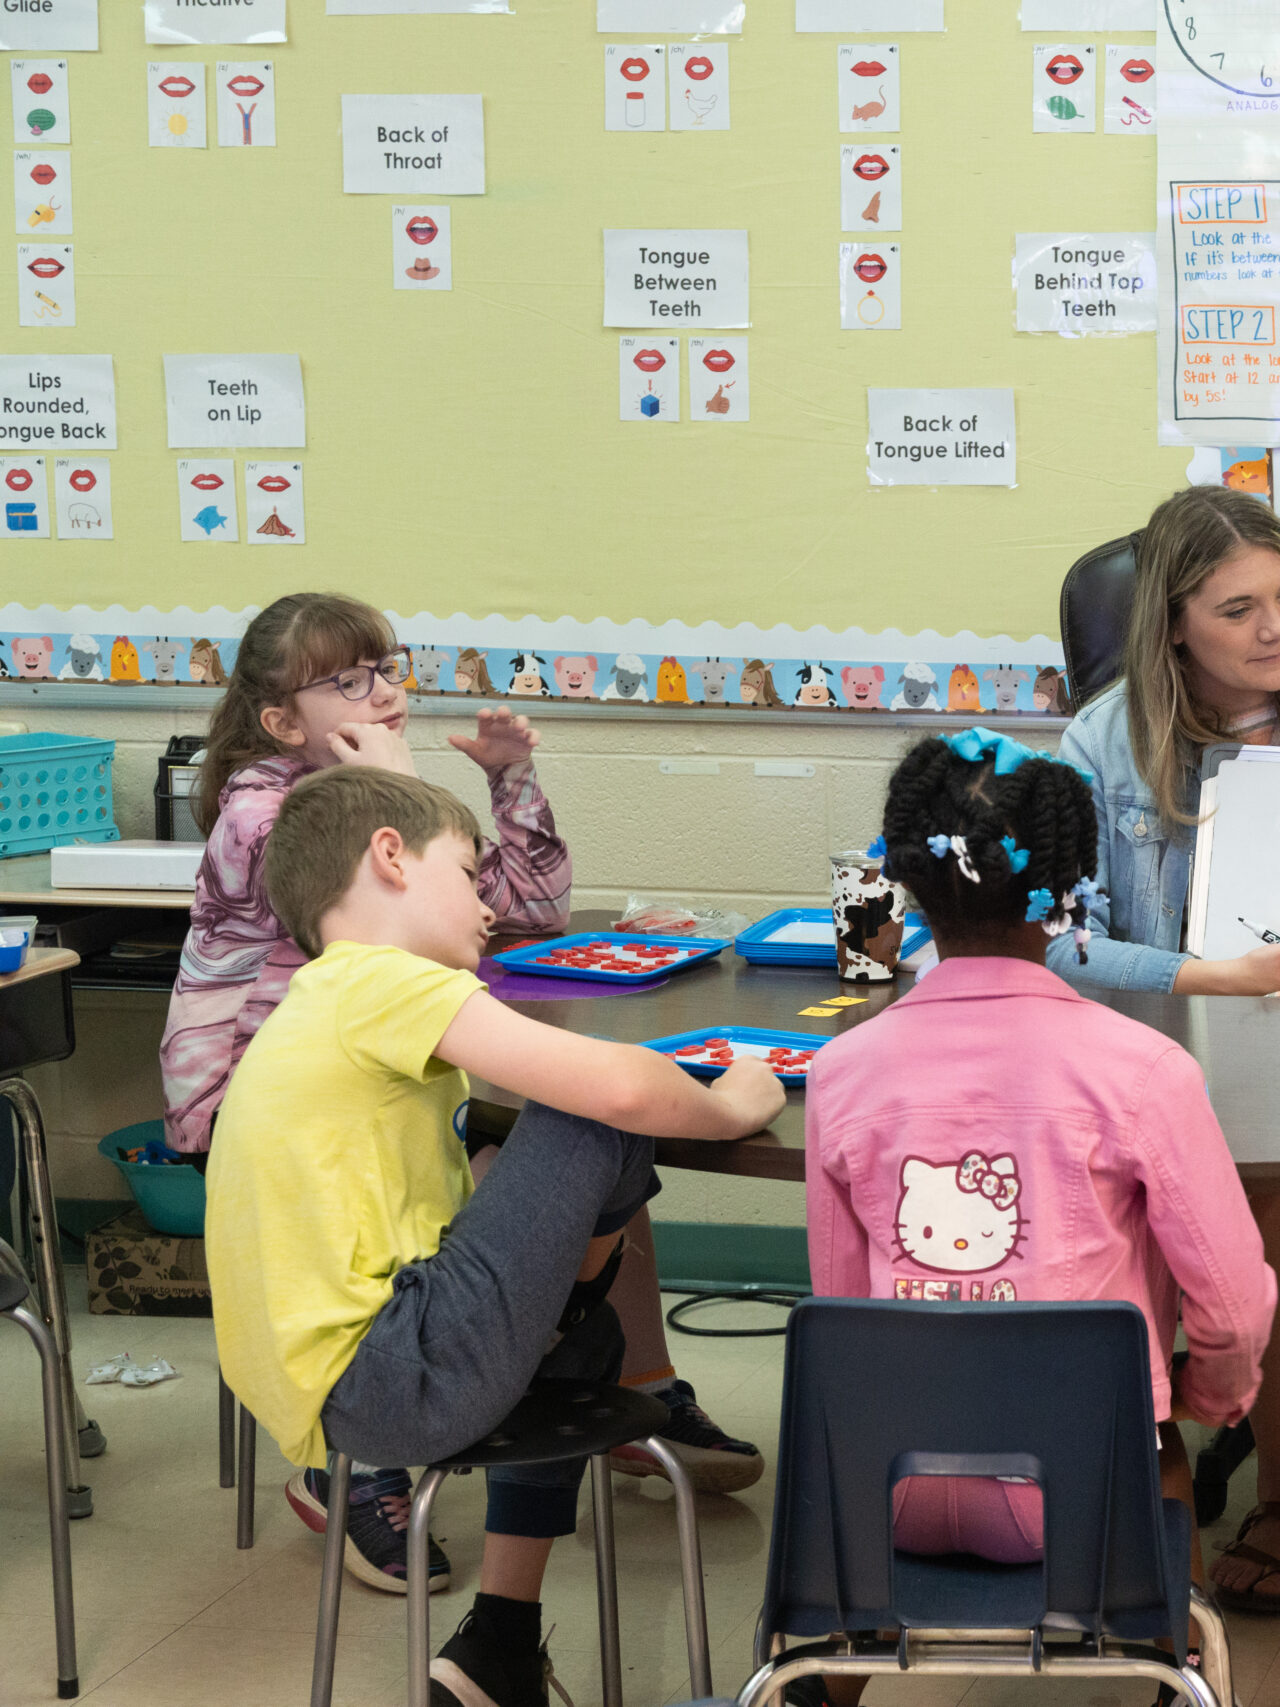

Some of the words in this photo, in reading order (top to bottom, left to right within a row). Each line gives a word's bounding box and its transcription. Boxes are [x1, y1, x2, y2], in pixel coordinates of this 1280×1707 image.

[1185, 17, 1197, 40] 8
[1210, 52, 1225, 70] 7
[1260, 65, 1273, 87] 6
[1226, 101, 1279, 111] ANALOG
[377, 126, 425, 144] Back
[431, 125, 449, 144] of
[384, 153, 442, 170] Throat
[1186, 187, 1242, 220] STEP
[1254, 187, 1260, 219] 1
[1192, 230, 1224, 247] Look
[1232, 231, 1246, 245] at
[1252, 231, 1271, 245] the
[640, 248, 710, 270] Tongue
[1052, 247, 1125, 270] Tongue
[1185, 251, 1198, 266] If
[634, 274, 717, 291] Between
[1184, 268, 1228, 281] numbers
[1238, 268, 1256, 280] look
[1262, 268, 1274, 279] at
[1035, 273, 1102, 291] Behind
[1109, 274, 1144, 296] Top
[649, 301, 701, 317] Teeth
[1062, 300, 1117, 317] Teeth
[1186, 309, 1244, 340] STEP
[1252, 310, 1268, 340] 2
[1186, 351, 1212, 365] Look
[1222, 353, 1236, 366] at
[1243, 353, 1260, 366] the
[29, 372, 62, 392] Lips
[1184, 370, 1216, 384] Start
[1225, 371, 1239, 384] at
[1248, 372, 1259, 384] 12
[208, 379, 259, 397] Teeth
[3, 397, 89, 415] Rounded,
[1184, 389, 1199, 407] by
[207, 408, 230, 423] on
[237, 406, 262, 426] Lip
[903, 415, 953, 433] Back
[959, 415, 978, 433] of
[0, 426, 55, 443] ongue
[62, 423, 107, 440] Back
[875, 442, 948, 462] Tongue
[954, 441, 1006, 459] Lifted
